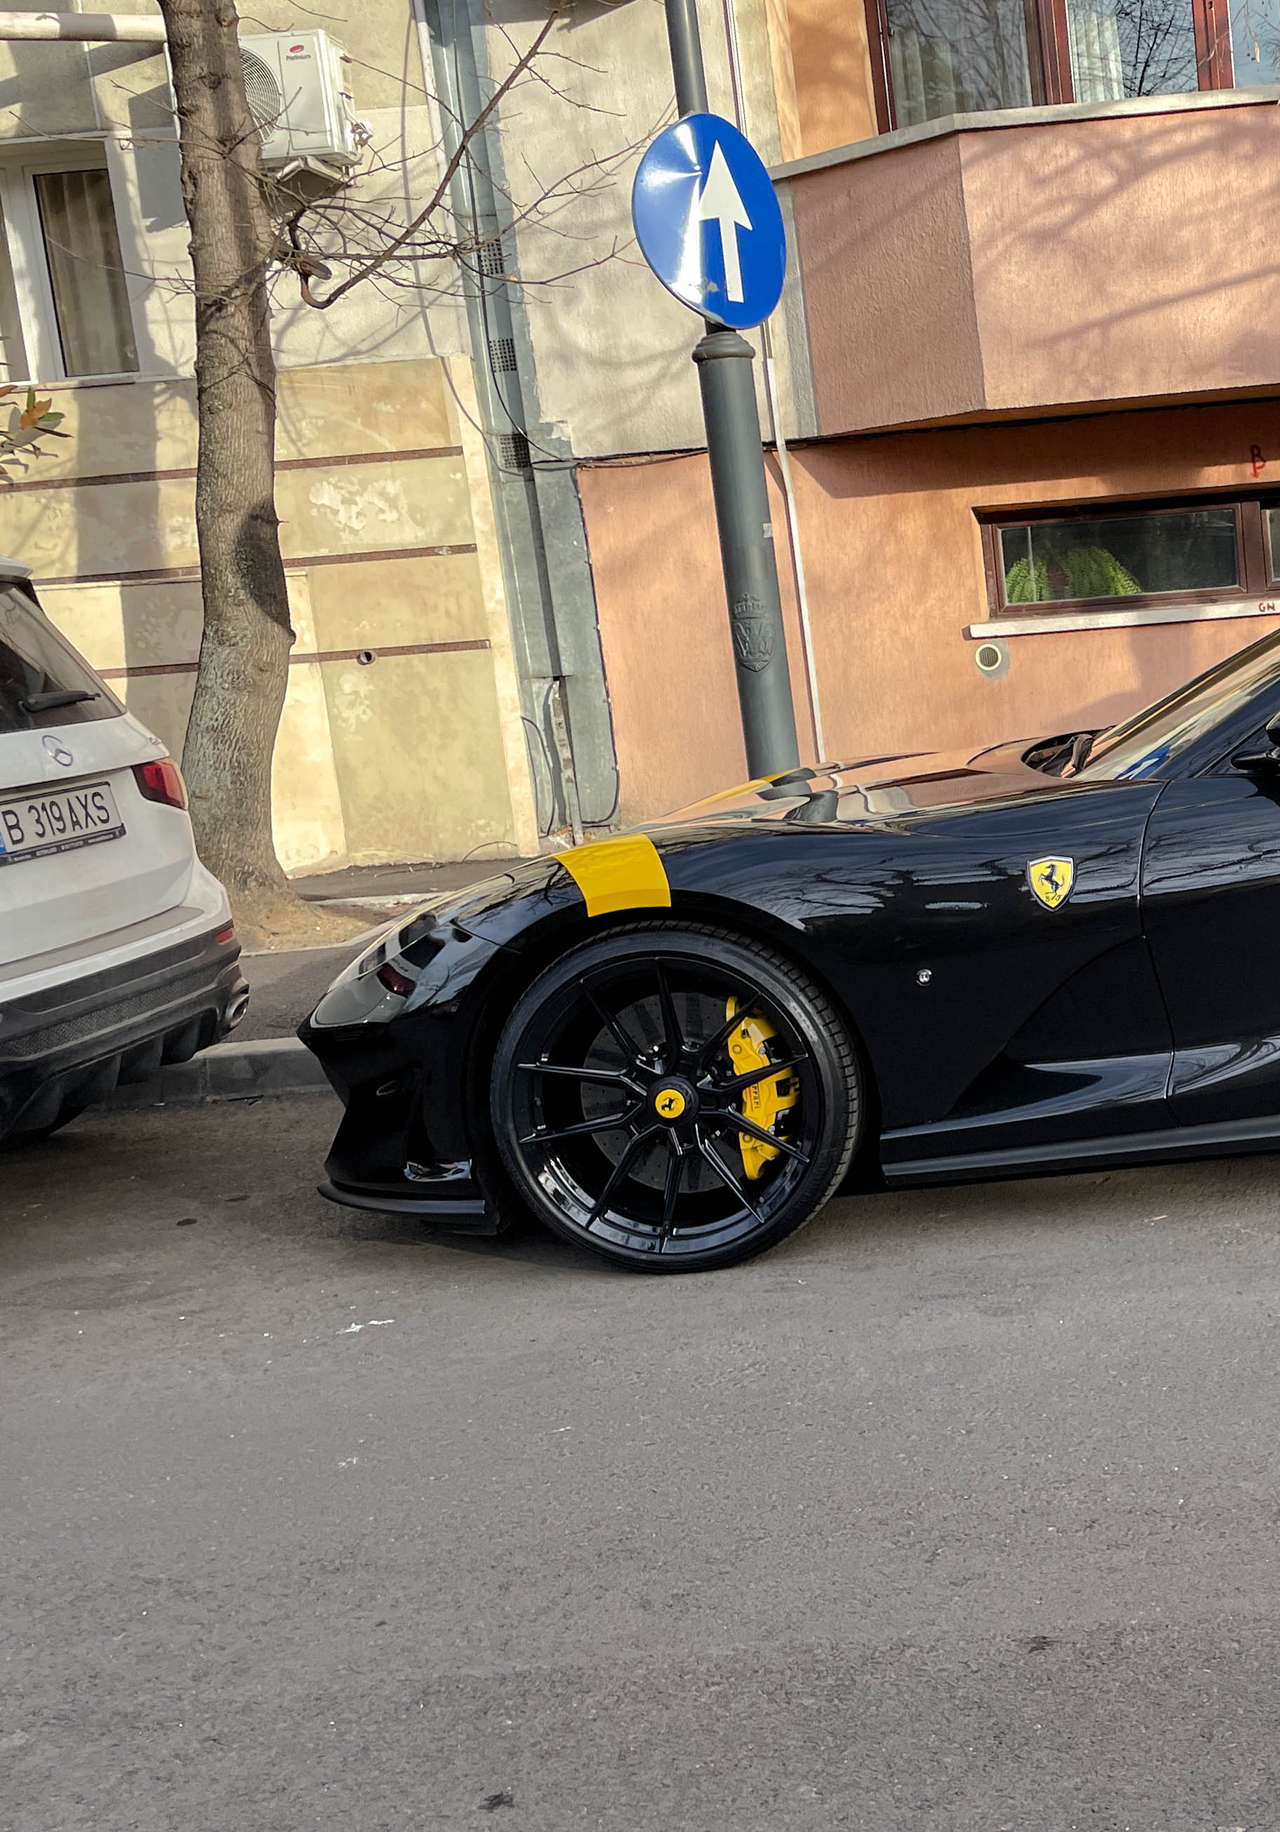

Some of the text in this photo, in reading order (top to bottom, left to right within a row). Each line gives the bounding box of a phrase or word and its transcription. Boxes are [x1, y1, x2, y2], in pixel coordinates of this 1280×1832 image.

[1258, 602, 1276, 613] GN
[1, 792, 110, 845] B 319 AXS
